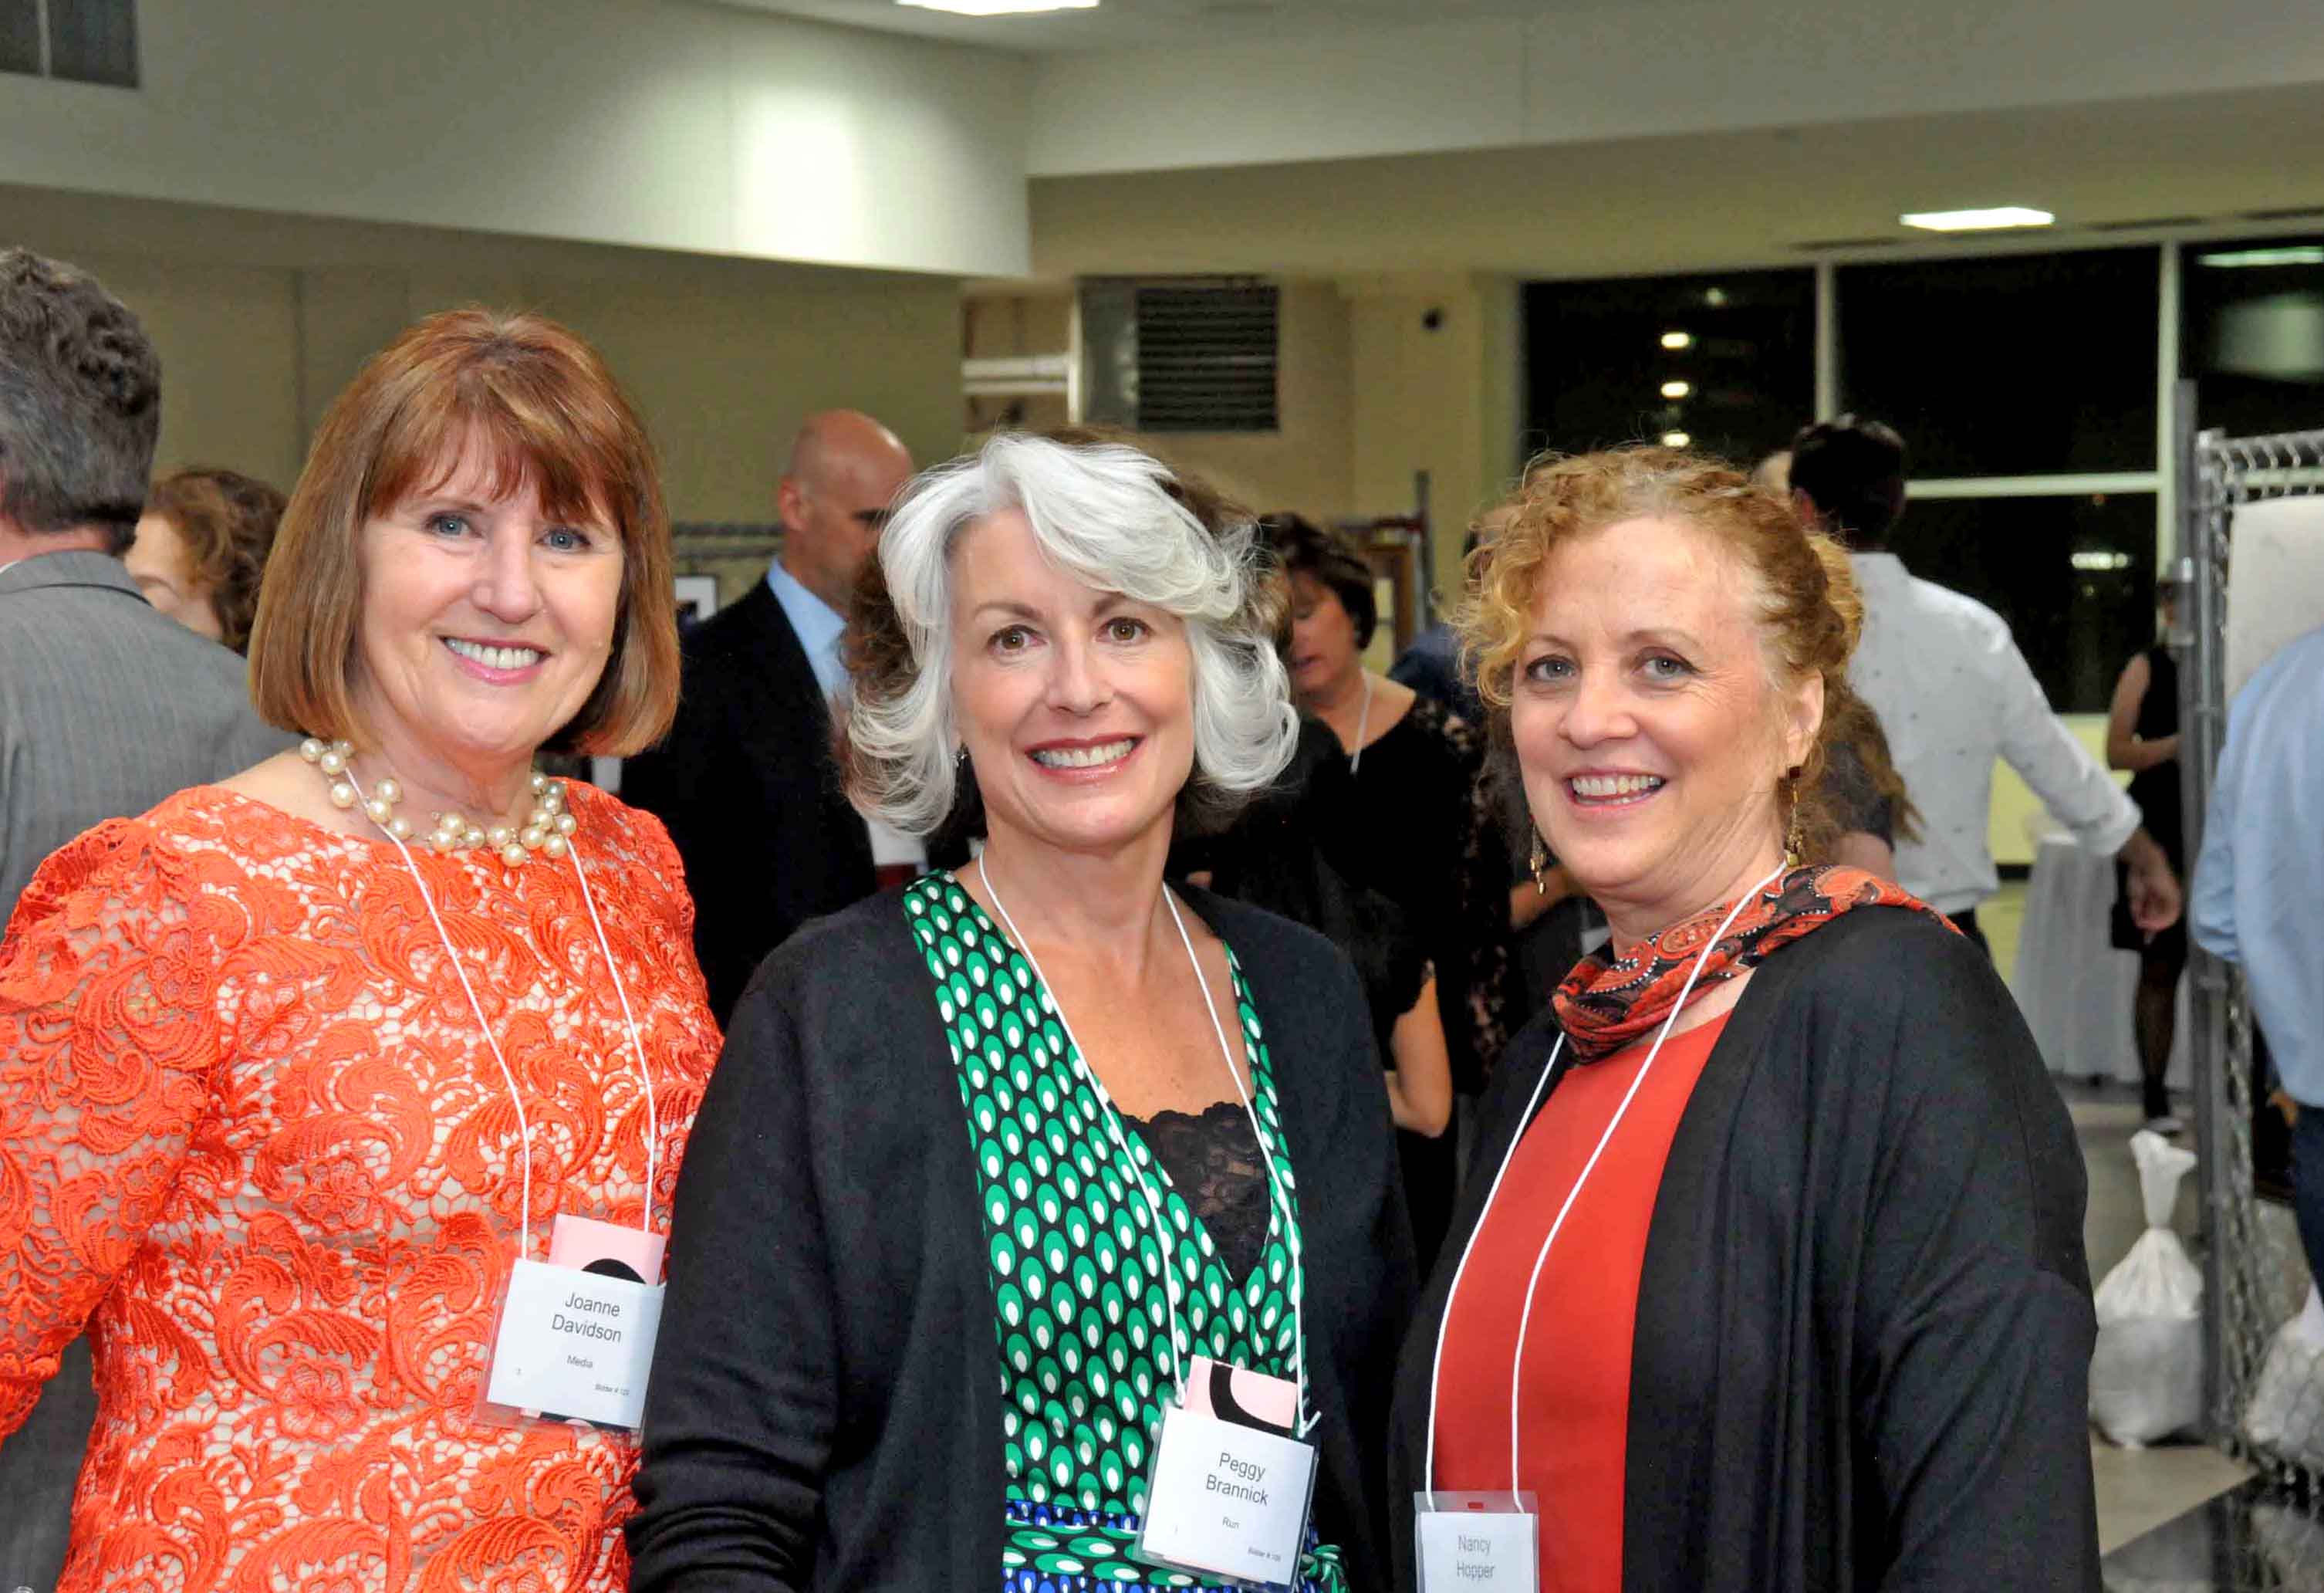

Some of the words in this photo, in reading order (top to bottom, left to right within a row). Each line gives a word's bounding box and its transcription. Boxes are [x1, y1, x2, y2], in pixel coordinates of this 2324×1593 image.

[565, 1292, 620, 1317] Joanne
[552, 1314, 621, 1342] Davidson
[567, 1355, 593, 1368] Media
[1219, 1452, 1266, 1482] Peggy
[1206, 1474, 1268, 1506] Brannick
[1458, 1534, 1491, 1556] Nancy
[1456, 1560, 1495, 1582] Hopper
